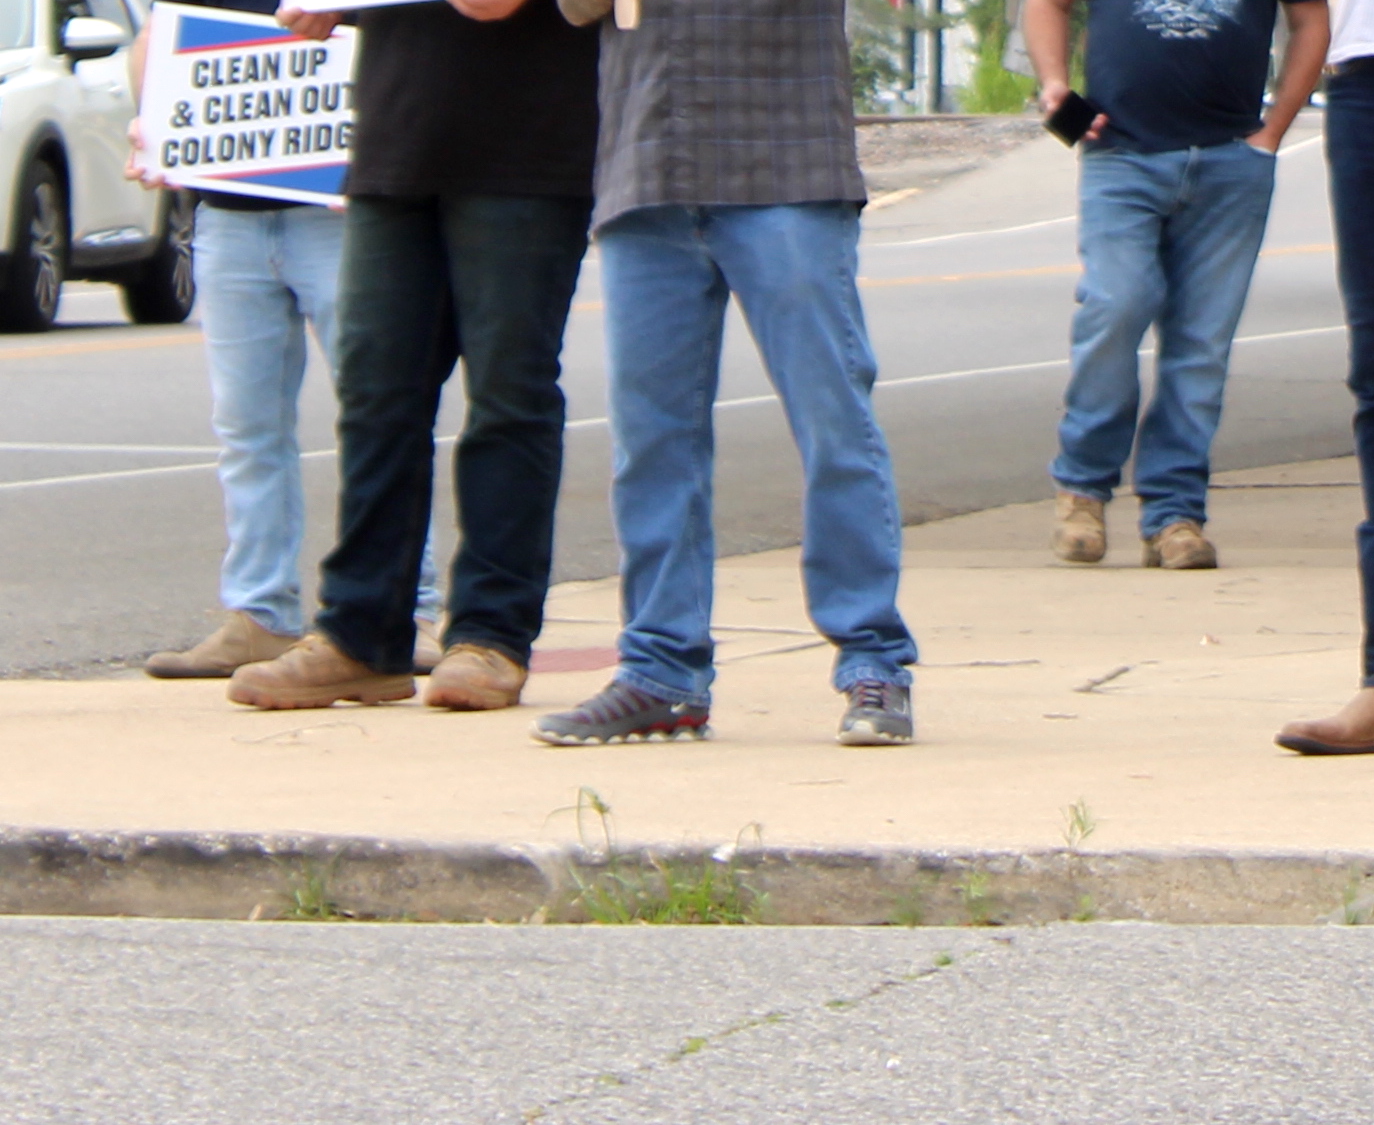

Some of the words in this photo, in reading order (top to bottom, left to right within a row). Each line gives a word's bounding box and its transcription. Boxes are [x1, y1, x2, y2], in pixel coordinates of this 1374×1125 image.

[192, 52, 281, 89] CLEAN
[289, 47, 328, 78] UP
[169, 100, 193, 128] &
[203, 88, 293, 125] CLEAN
[301, 82, 355, 114] OUT
[160, 128, 276, 168] COLONY
[282, 120, 354, 156] RIDG
